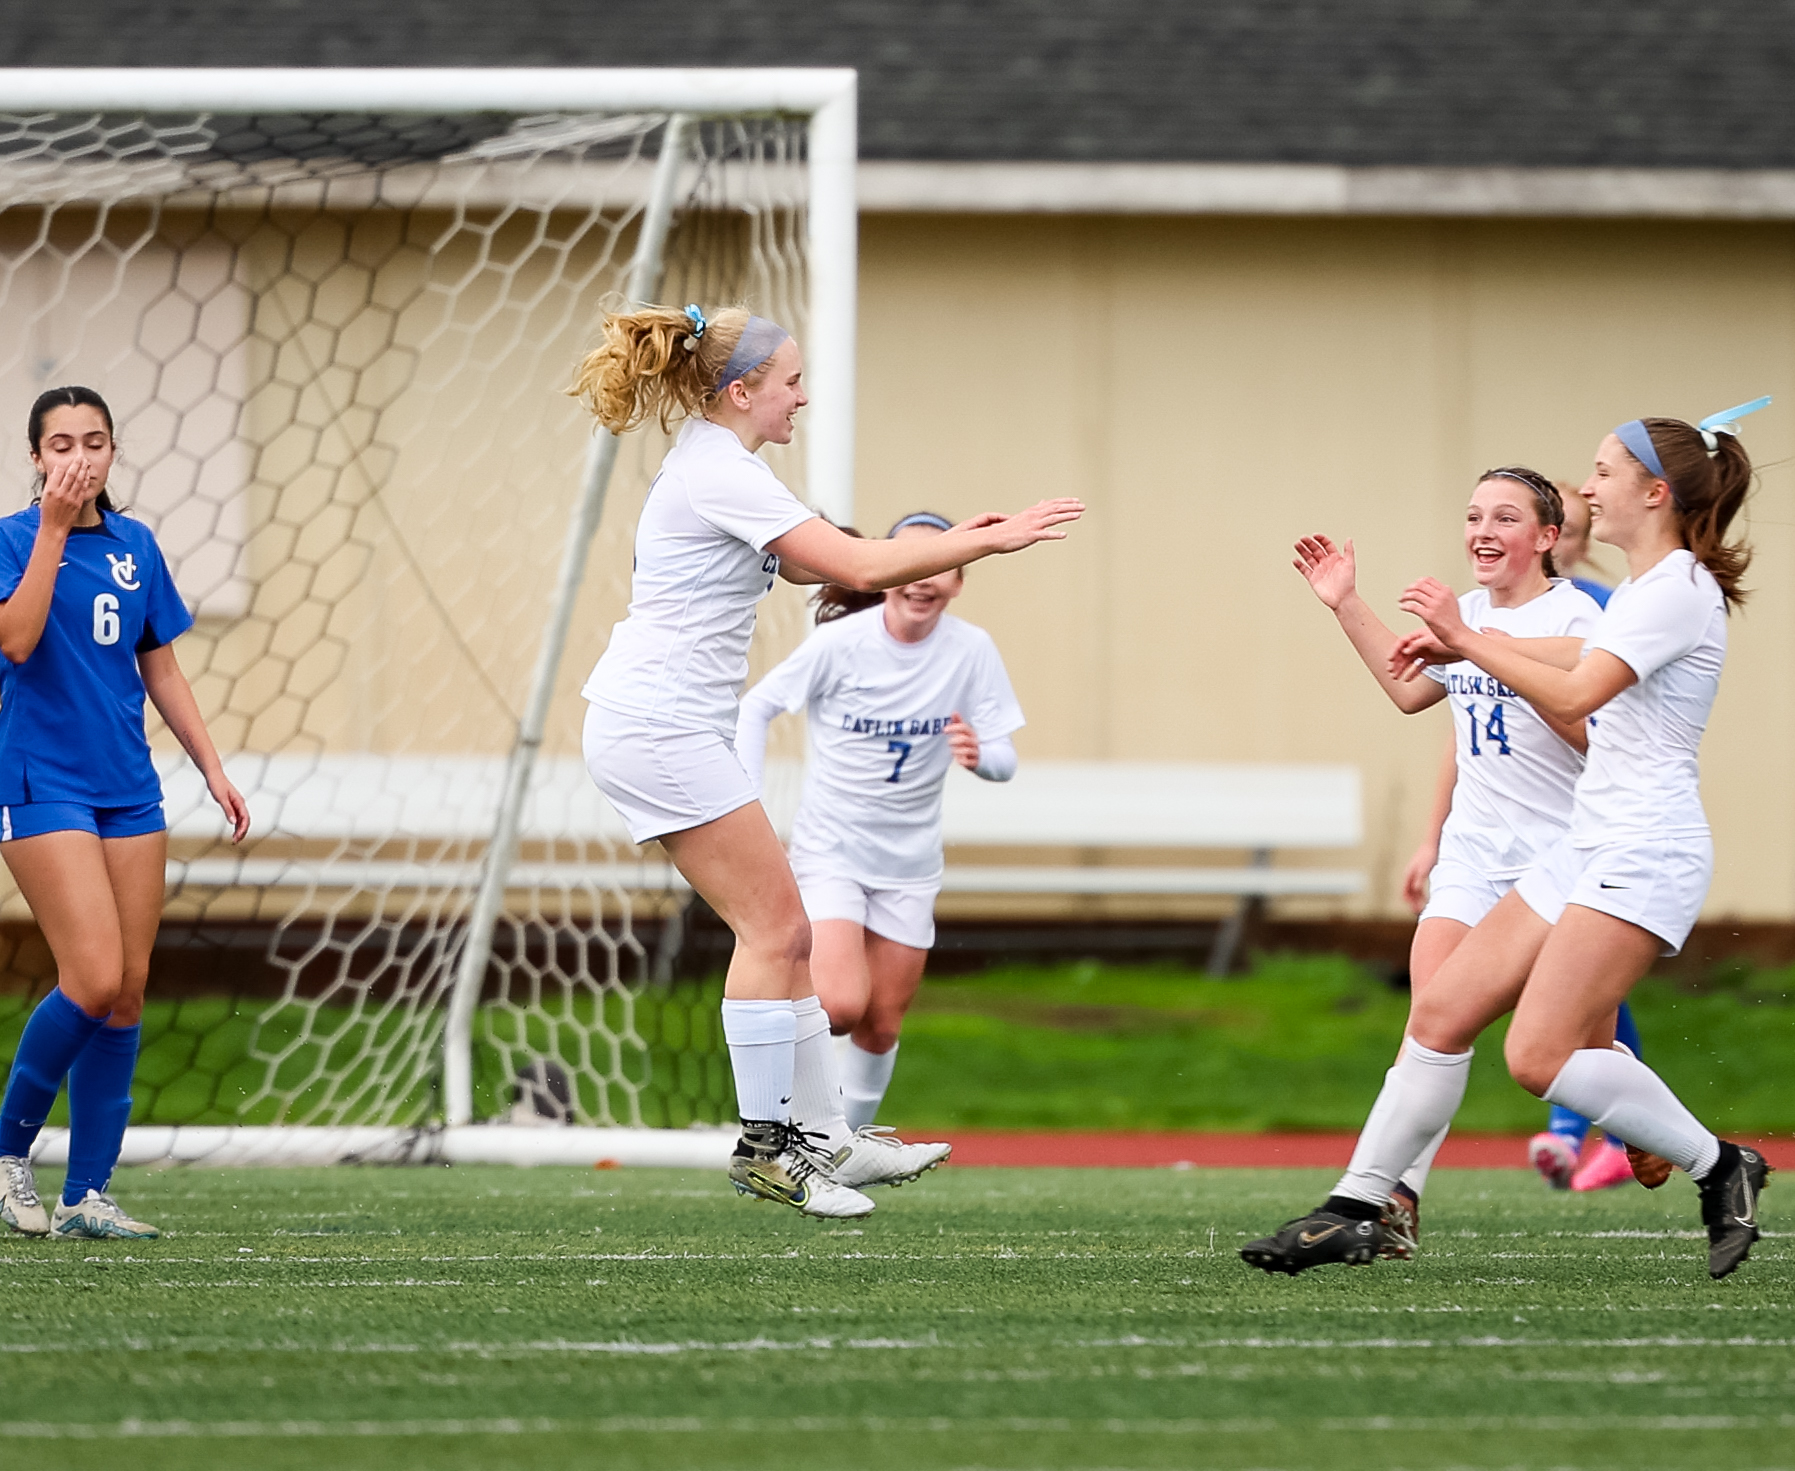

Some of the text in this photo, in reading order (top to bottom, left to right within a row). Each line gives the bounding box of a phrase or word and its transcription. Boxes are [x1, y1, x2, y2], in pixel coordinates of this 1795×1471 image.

[93, 592, 120, 646] 6
[842, 714, 903, 736] CATLIN
[1466, 702, 1511, 756] 14
[884, 740, 912, 783] 7
